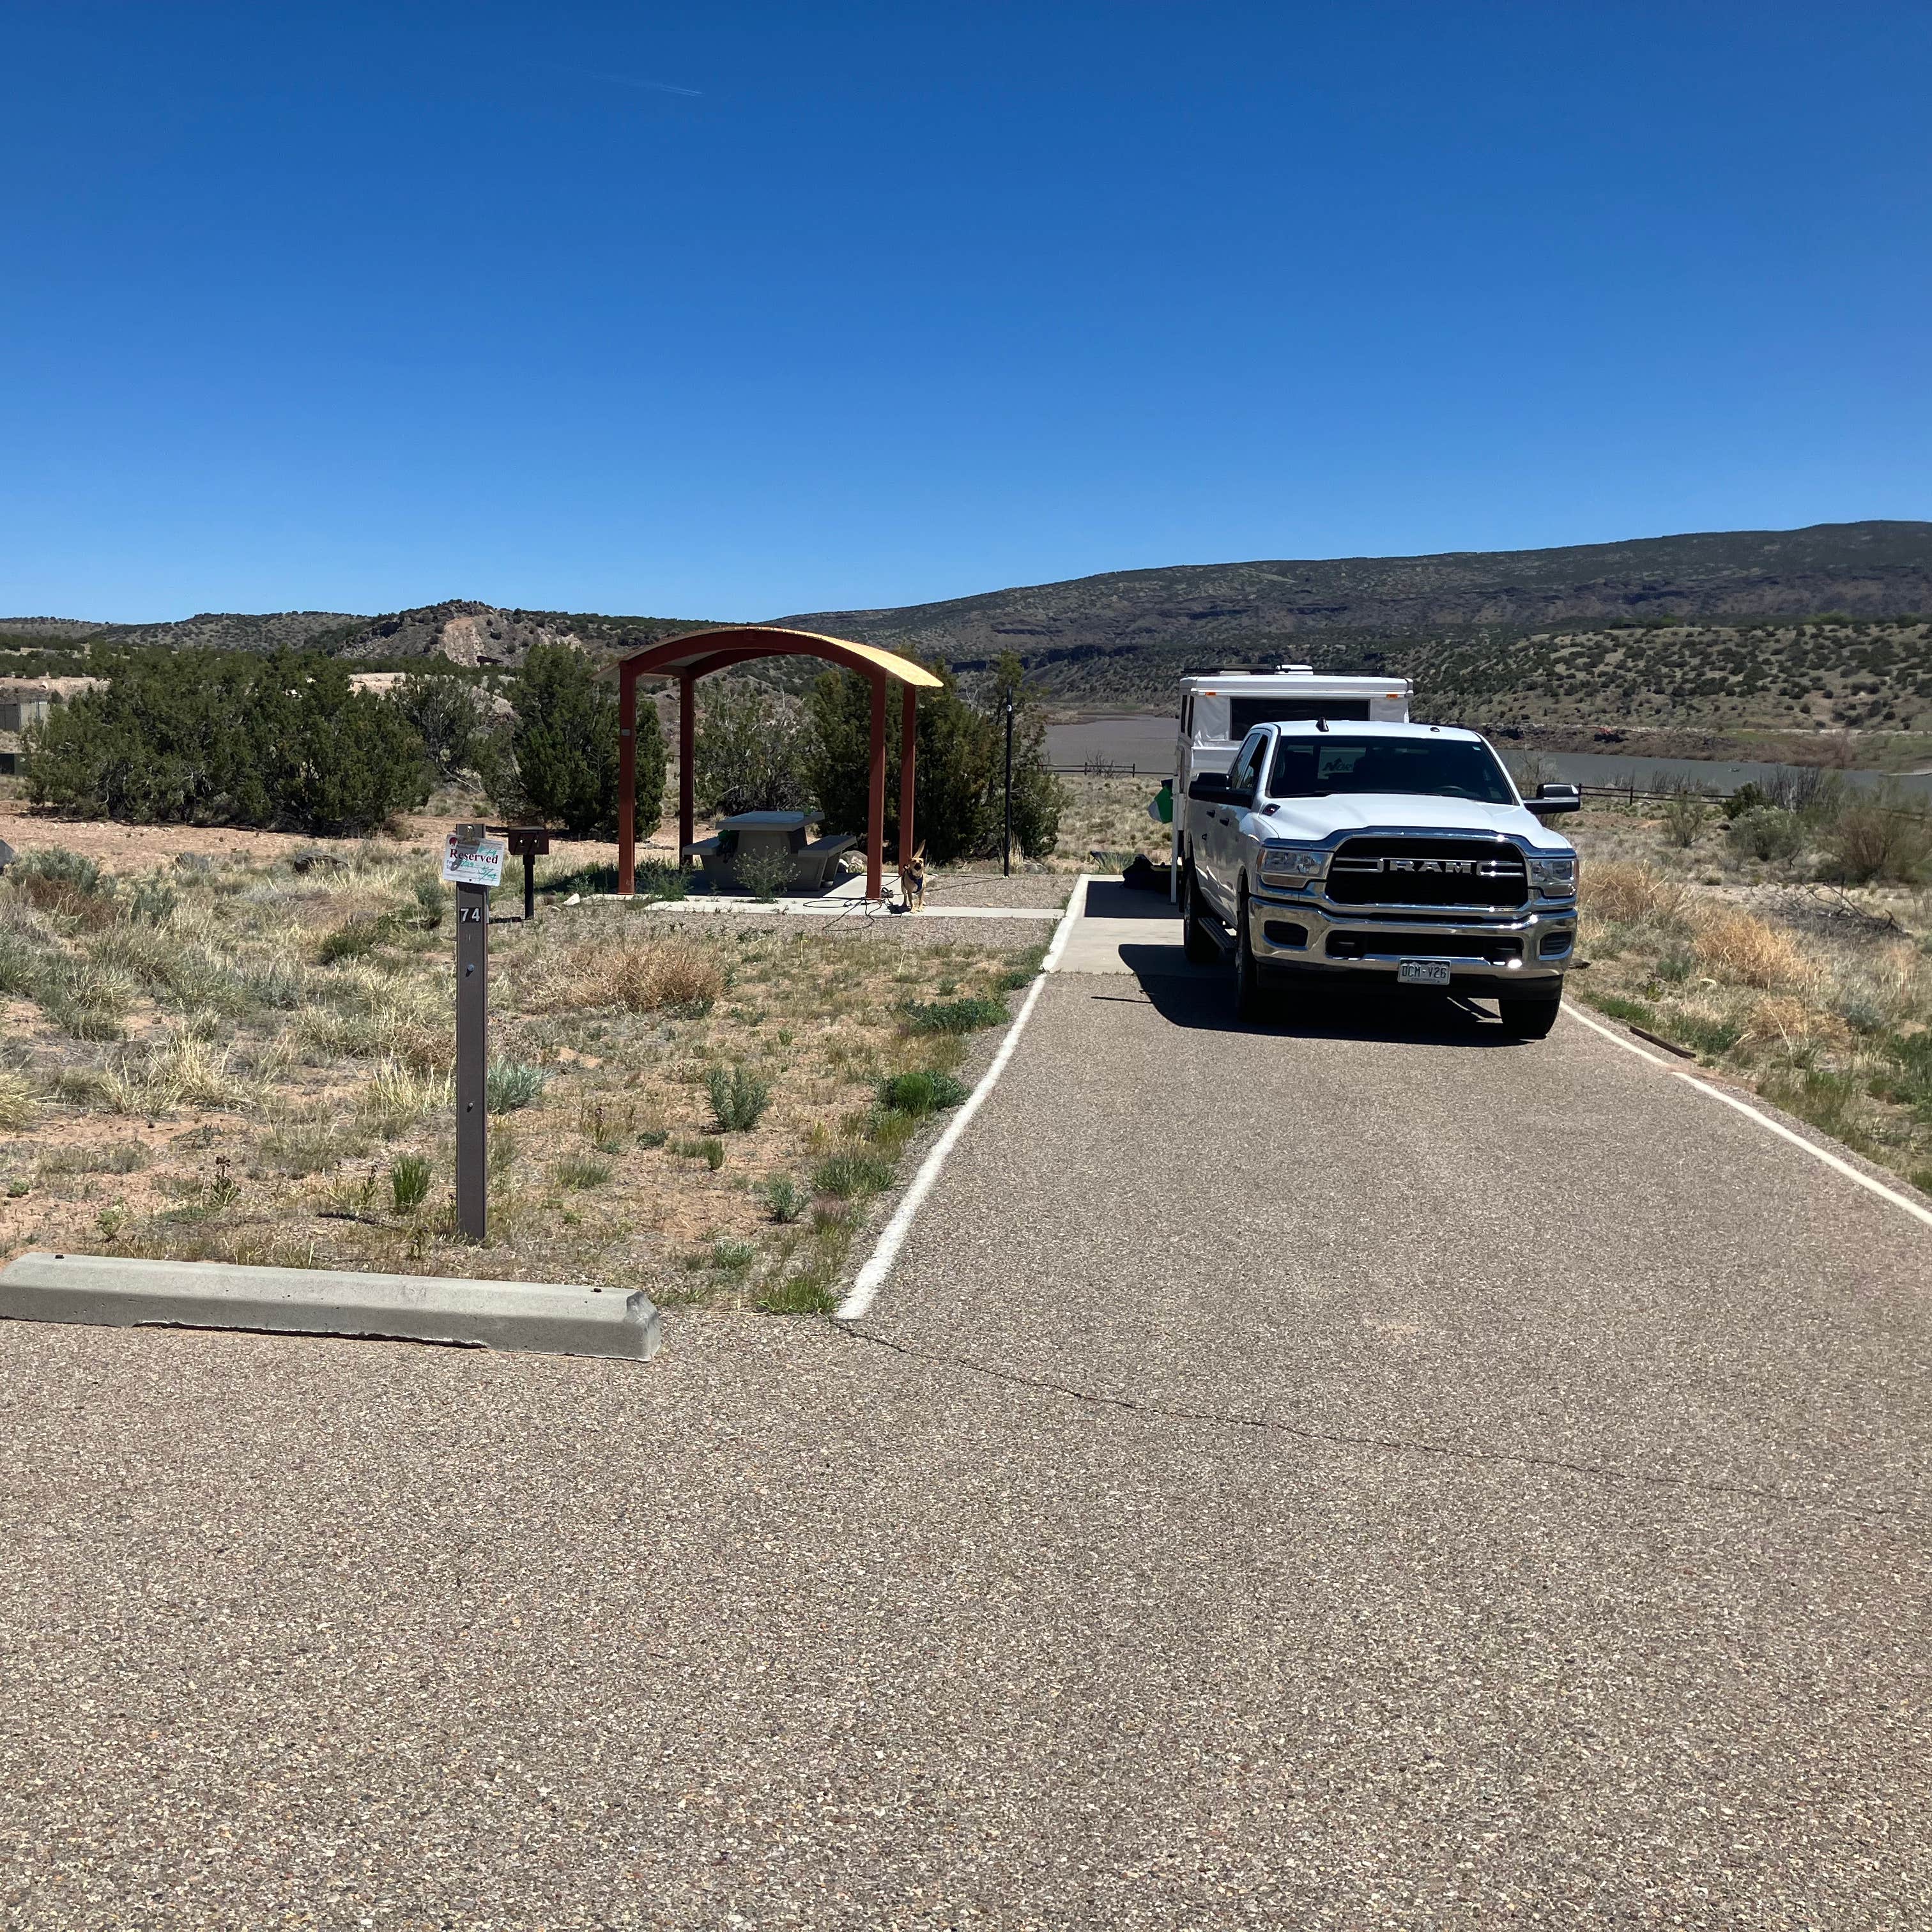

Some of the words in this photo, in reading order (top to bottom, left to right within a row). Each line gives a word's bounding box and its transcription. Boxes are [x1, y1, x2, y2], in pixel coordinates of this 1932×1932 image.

[450, 848, 498, 864] Reserved
[1390, 860, 1471, 873] RAM
[461, 908, 480, 921] 74
